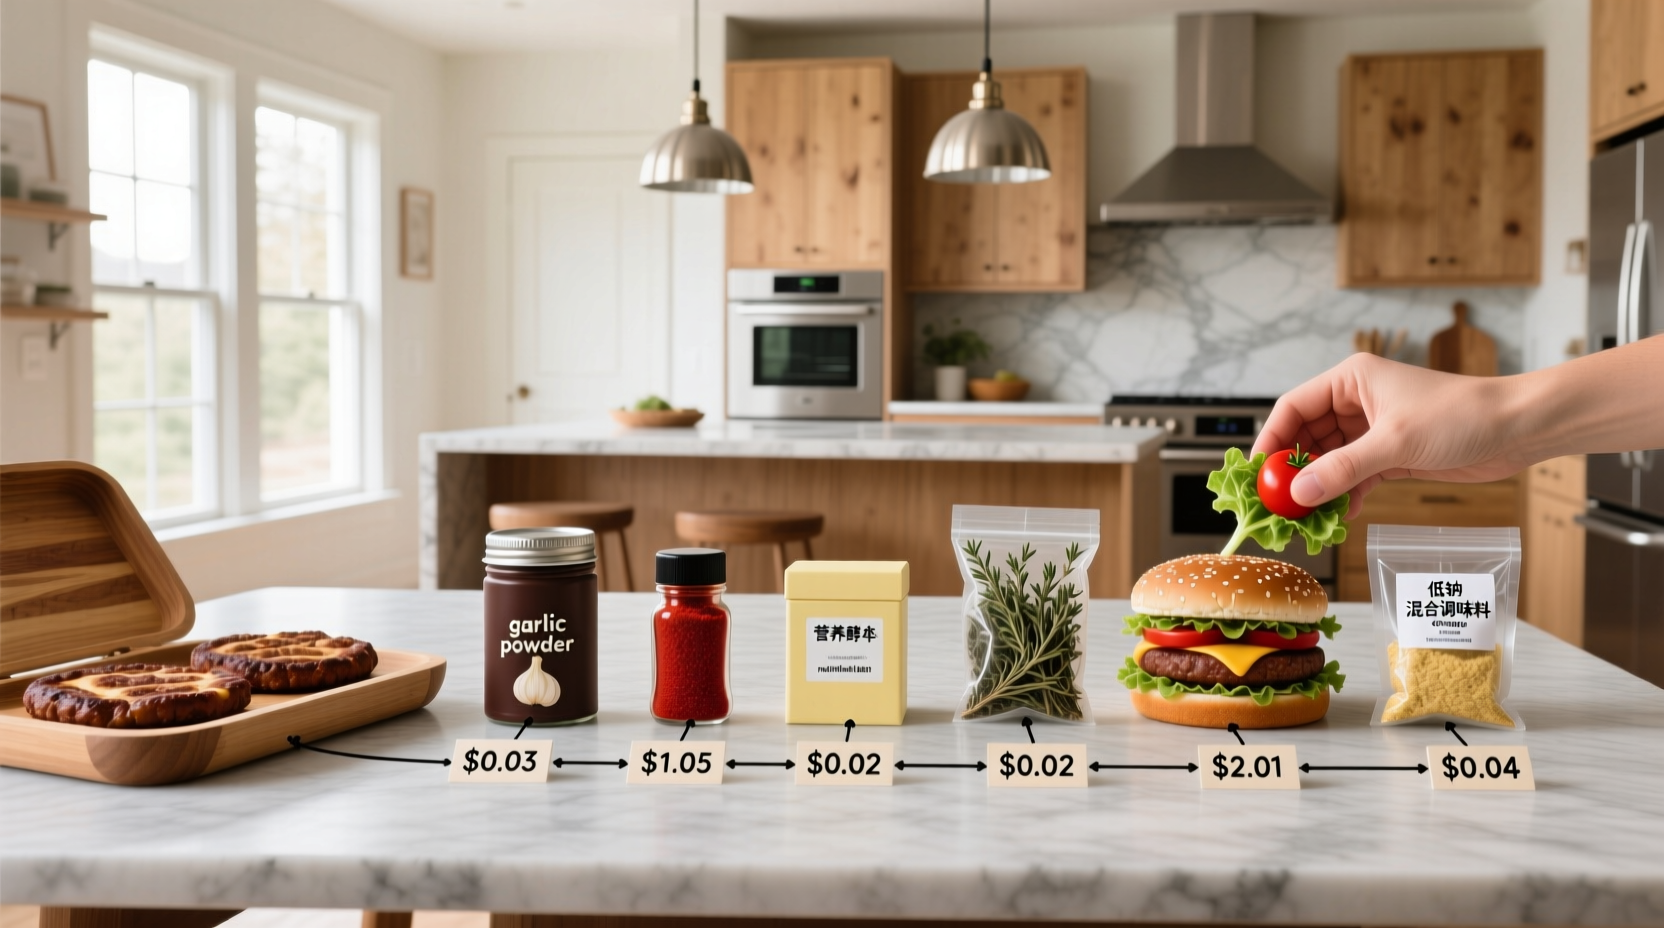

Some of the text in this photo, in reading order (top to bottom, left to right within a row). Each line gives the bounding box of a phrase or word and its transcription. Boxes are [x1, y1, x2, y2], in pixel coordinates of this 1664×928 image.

[1406, 600, 1492, 619] 混合调味料
[509, 613, 567, 638] garlic
[500, 635, 575, 658] powder
[462, 747, 538, 775] $0.03
[641, 748, 712, 776] $1.05
[807, 749, 881, 777] $0.02
[999, 751, 1074, 780] $0.02
[1212, 751, 1282, 780] $2.01
[1441, 752, 1521, 782] $0.04
